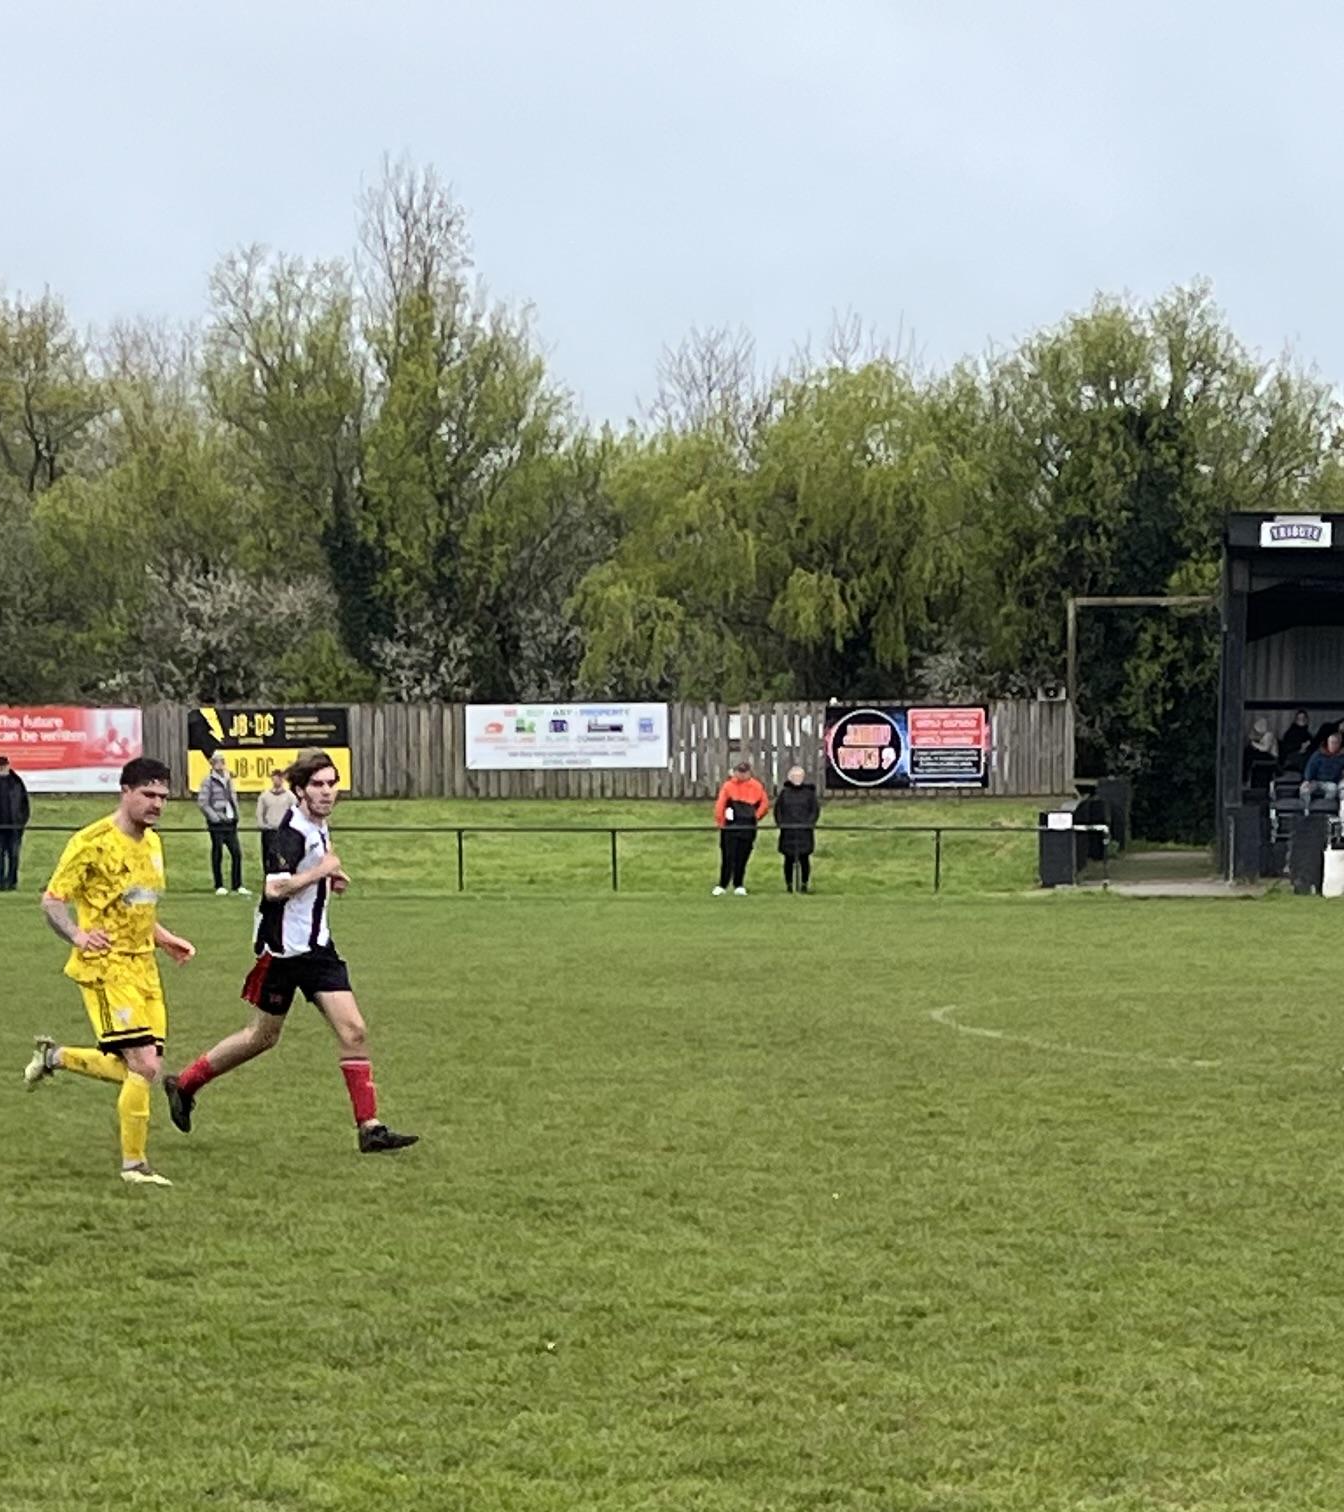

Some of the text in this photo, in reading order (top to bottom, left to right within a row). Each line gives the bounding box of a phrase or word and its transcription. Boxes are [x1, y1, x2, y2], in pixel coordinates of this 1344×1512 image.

[22, 714, 64, 729] future
[21, 729, 39, 743] be
[40, 729, 88, 743] written
